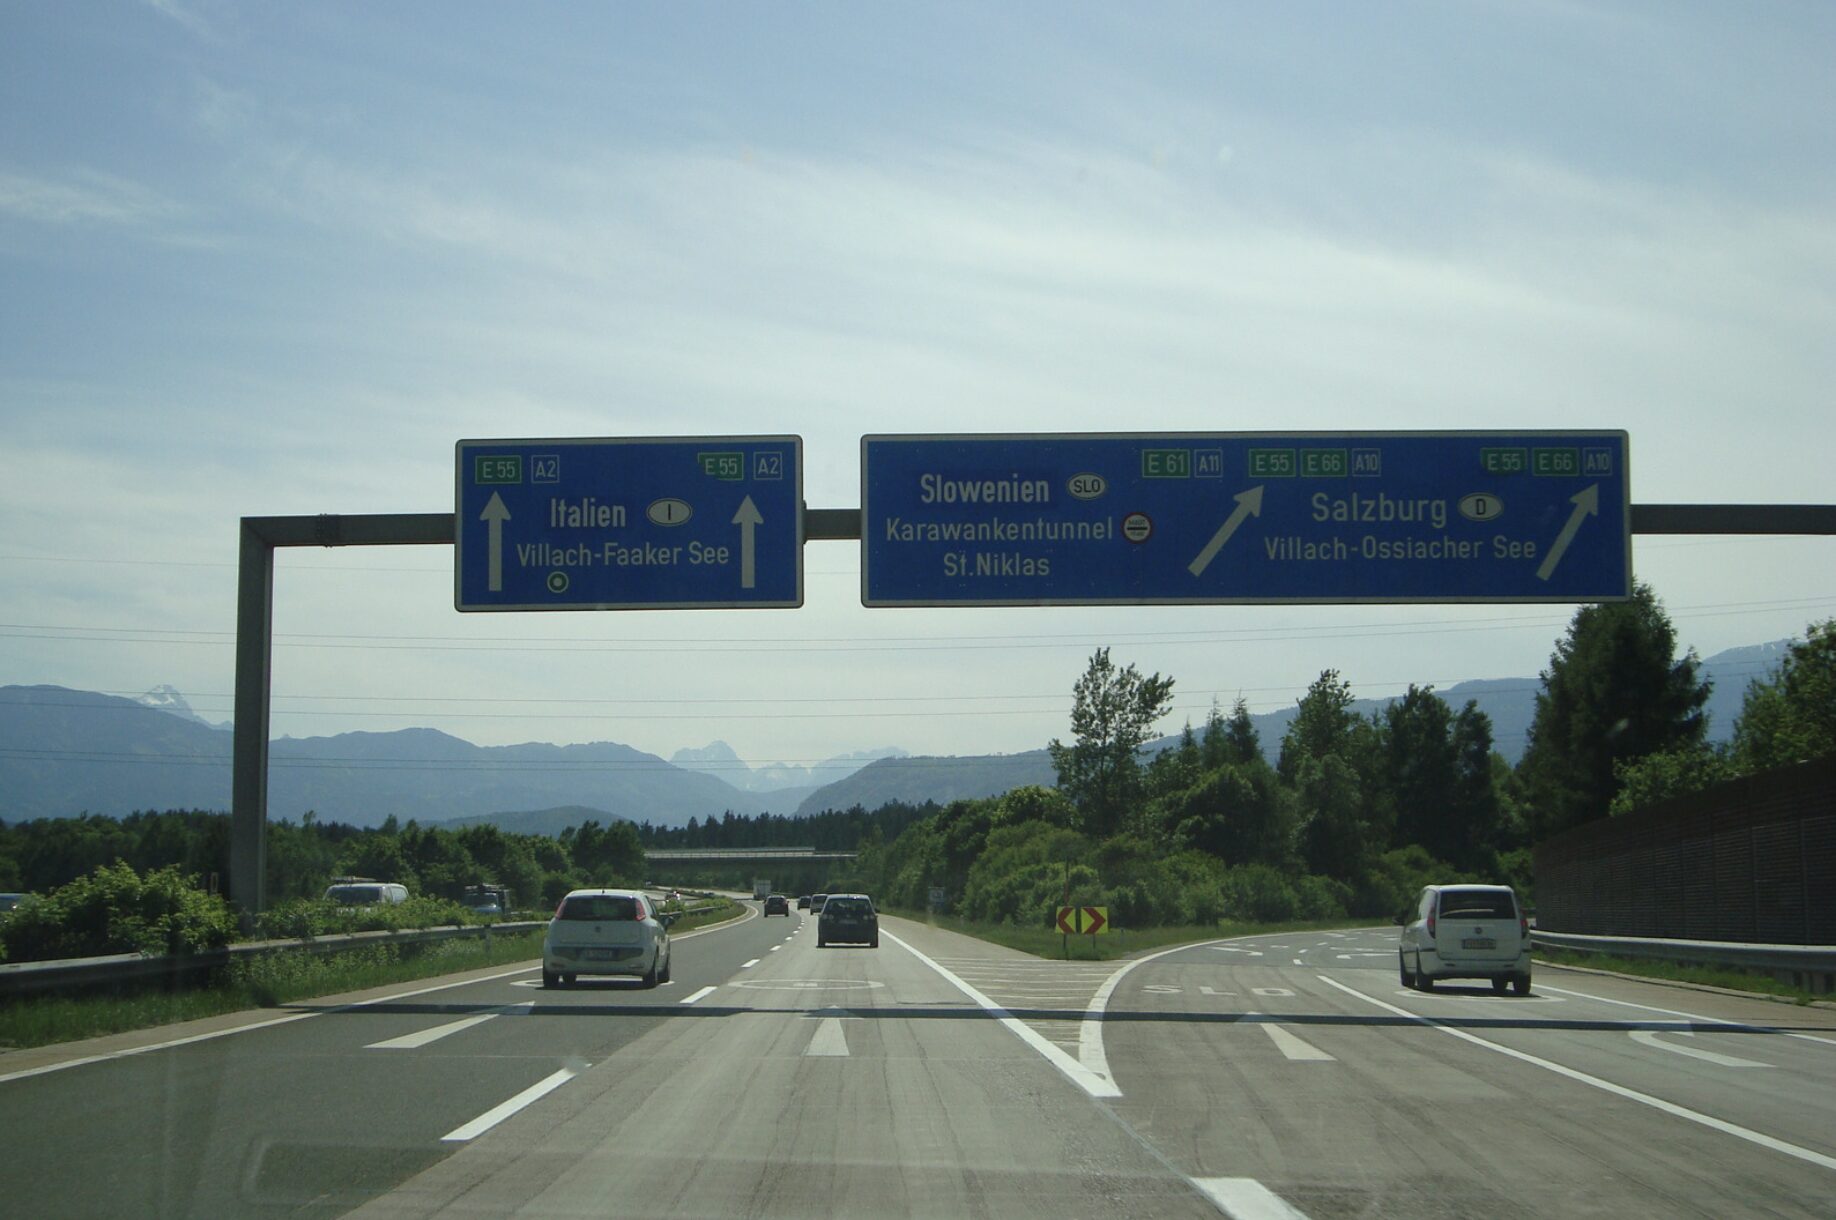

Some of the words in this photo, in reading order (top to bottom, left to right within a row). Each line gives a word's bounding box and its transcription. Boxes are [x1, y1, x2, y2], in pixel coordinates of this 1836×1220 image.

[483, 462, 492, 478] E
[497, 462, 516, 478] 55
[535, 462, 556, 479] A2
[705, 458, 715, 475] E
[719, 458, 738, 475] 55
[758, 458, 779, 475] A2
[1149, 455, 1158, 473] E
[1166, 455, 1186, 473] 61
[1199, 455, 1220, 472] A11
[1256, 455, 1265, 471] E
[1270, 455, 1289, 471] 55
[1308, 455, 1317, 471] E
[1322, 455, 1341, 471] 66
[1355, 455, 1378, 471] A10
[1488, 454, 1498, 470] E
[1502, 454, 1521, 470] 55
[1539, 454, 1549, 470] E
[1553, 454, 1572, 470] 66
[1587, 454, 1610, 470] A10
[920, 473, 1049, 503] Slowenien
[1073, 479, 1100, 494] SLO
[550, 498, 626, 527] Italien
[1311, 493, 1447, 529] Salzburg
[1475, 499, 1486, 516] D
[886, 517, 1113, 541] Karawankentunnel
[517, 542, 682, 567] Villach-Faaker
[688, 541, 729, 565] See
[1264, 536, 1483, 561] Villach-Ossiacher
[1493, 535, 1536, 559] See
